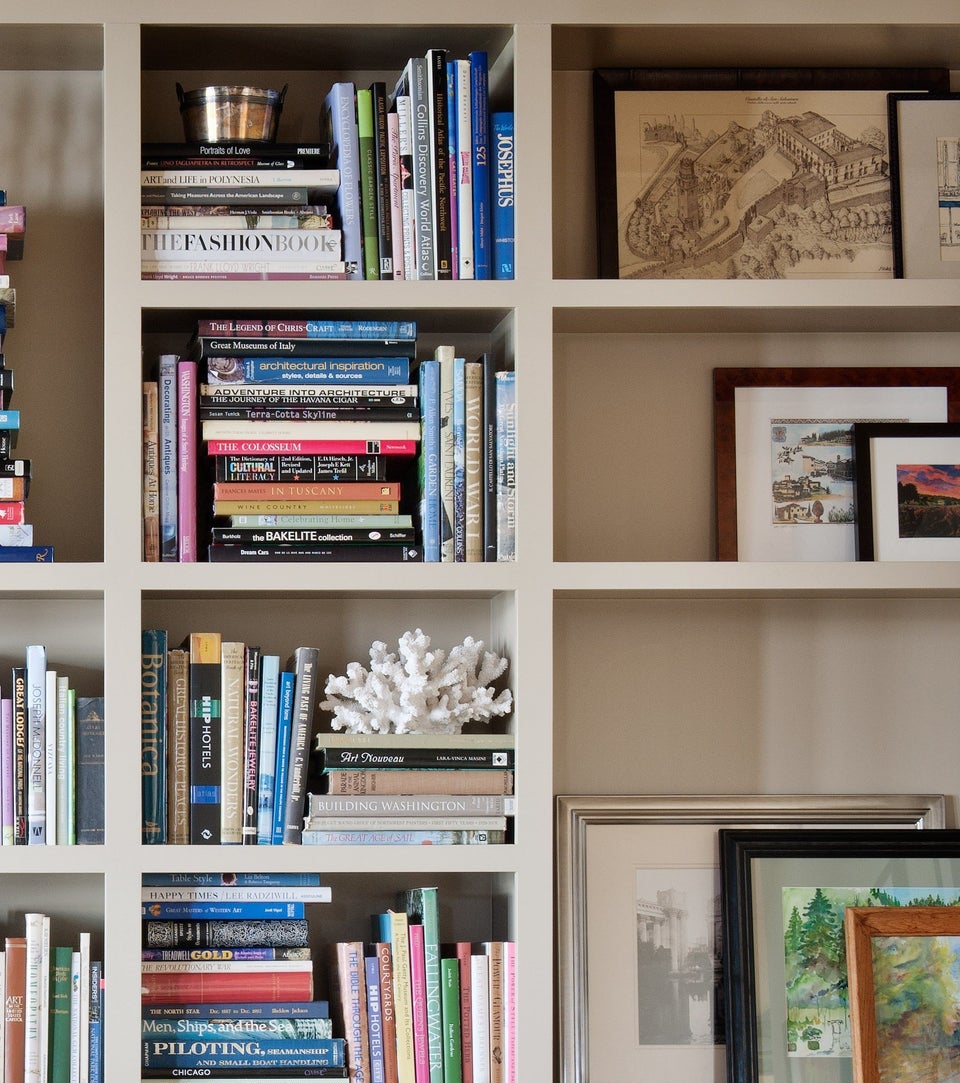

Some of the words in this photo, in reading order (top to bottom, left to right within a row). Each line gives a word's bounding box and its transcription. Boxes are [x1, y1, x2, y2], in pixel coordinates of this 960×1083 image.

[341, 96, 351, 165] ENCYCLOPEDIA
[417, 104, 425, 140] Collins
[199, 146, 226, 155] Portraits
[227, 146, 234, 155] of
[234, 146, 251, 155] Love
[476, 146, 487, 166] 125
[344, 167, 352, 180] OF
[417, 144, 428, 197] Discovery
[496, 133, 513, 208] JOSEPHUS
[170, 192, 186, 200] Taking
[258, 192, 284, 200] Landscape
[345, 182, 354, 226] FLOWERS
[420, 200, 431, 232] World
[421, 234, 432, 264] Atlas
[209, 323, 227, 332] THE
[229, 323, 263, 332] LEGEND
[277, 323, 334, 333] CHRIS-CRAFT
[210, 342, 231, 350] Great
[232, 342, 268, 350] Museums
[269, 341, 277, 350] of
[278, 342, 296, 352] Italy
[259, 361, 327, 371] architectural
[329, 361, 385, 372] inspiration
[163, 379, 172, 424] Decorating
[181, 370, 191, 416] WASHINGTON
[318, 389, 406, 397] ARCHITECTURE
[246, 410, 300, 419] Terra-Cotta
[302, 410, 337, 420] Skyline
[216, 442, 239, 451] THE
[241, 442, 301, 451] COLOSSEUM
[466, 397, 480, 474] WORLD
[163, 438, 173, 475] Antiques
[230, 462, 276, 473] CULTURAL
[230, 473, 275, 481] LITERACY
[428, 453, 438, 496] GARDEN
[271, 487, 284, 496] IN
[289, 486, 343, 496] TUSCANY
[466, 480, 480, 522] WAR
[252, 533, 265, 542] the
[265, 531, 317, 542] BAKELITE
[318, 533, 353, 542] collection
[466, 528, 480, 538] I
[15, 677, 24, 709] GREAT
[141, 653, 163, 776] Botanica
[202, 695, 211, 724] HIP
[227, 677, 240, 744] NATURAL
[248, 700, 258, 747] BAKELITE
[15, 711, 25, 748] LODGES
[202, 725, 212, 769] HOTELS
[340, 751, 358, 764] Art
[361, 751, 405, 764] Nouveau
[226, 747, 239, 819] WONDERS
[247, 748, 257, 791] JEWELRY
[318, 801, 378, 812] BUILDING
[381, 801, 466, 812] WASHINGTON
[161, 950, 191, 961] TREADWELL
[191, 950, 233, 960] GOLD
[348, 951, 358, 968] THE
[350, 970, 360, 994] BIBLE
[381, 947, 393, 1022] COURTYARDS
[369, 985, 378, 1013] HIP
[426, 944, 441, 1072] FALLINGWATER
[142, 1020, 176, 1034] Men,
[219, 1019, 244, 1033] and
[244, 1019, 267, 1033] the
[269, 1019, 292, 1034] Sea
[351, 997, 361, 1043] THROUGH
[153, 1042, 266, 1057] PILOTING,
[370, 1014, 381, 1056] HOTELS
[352, 1044, 362, 1062] THE
[172, 1068, 211, 1076] CHICAGO
